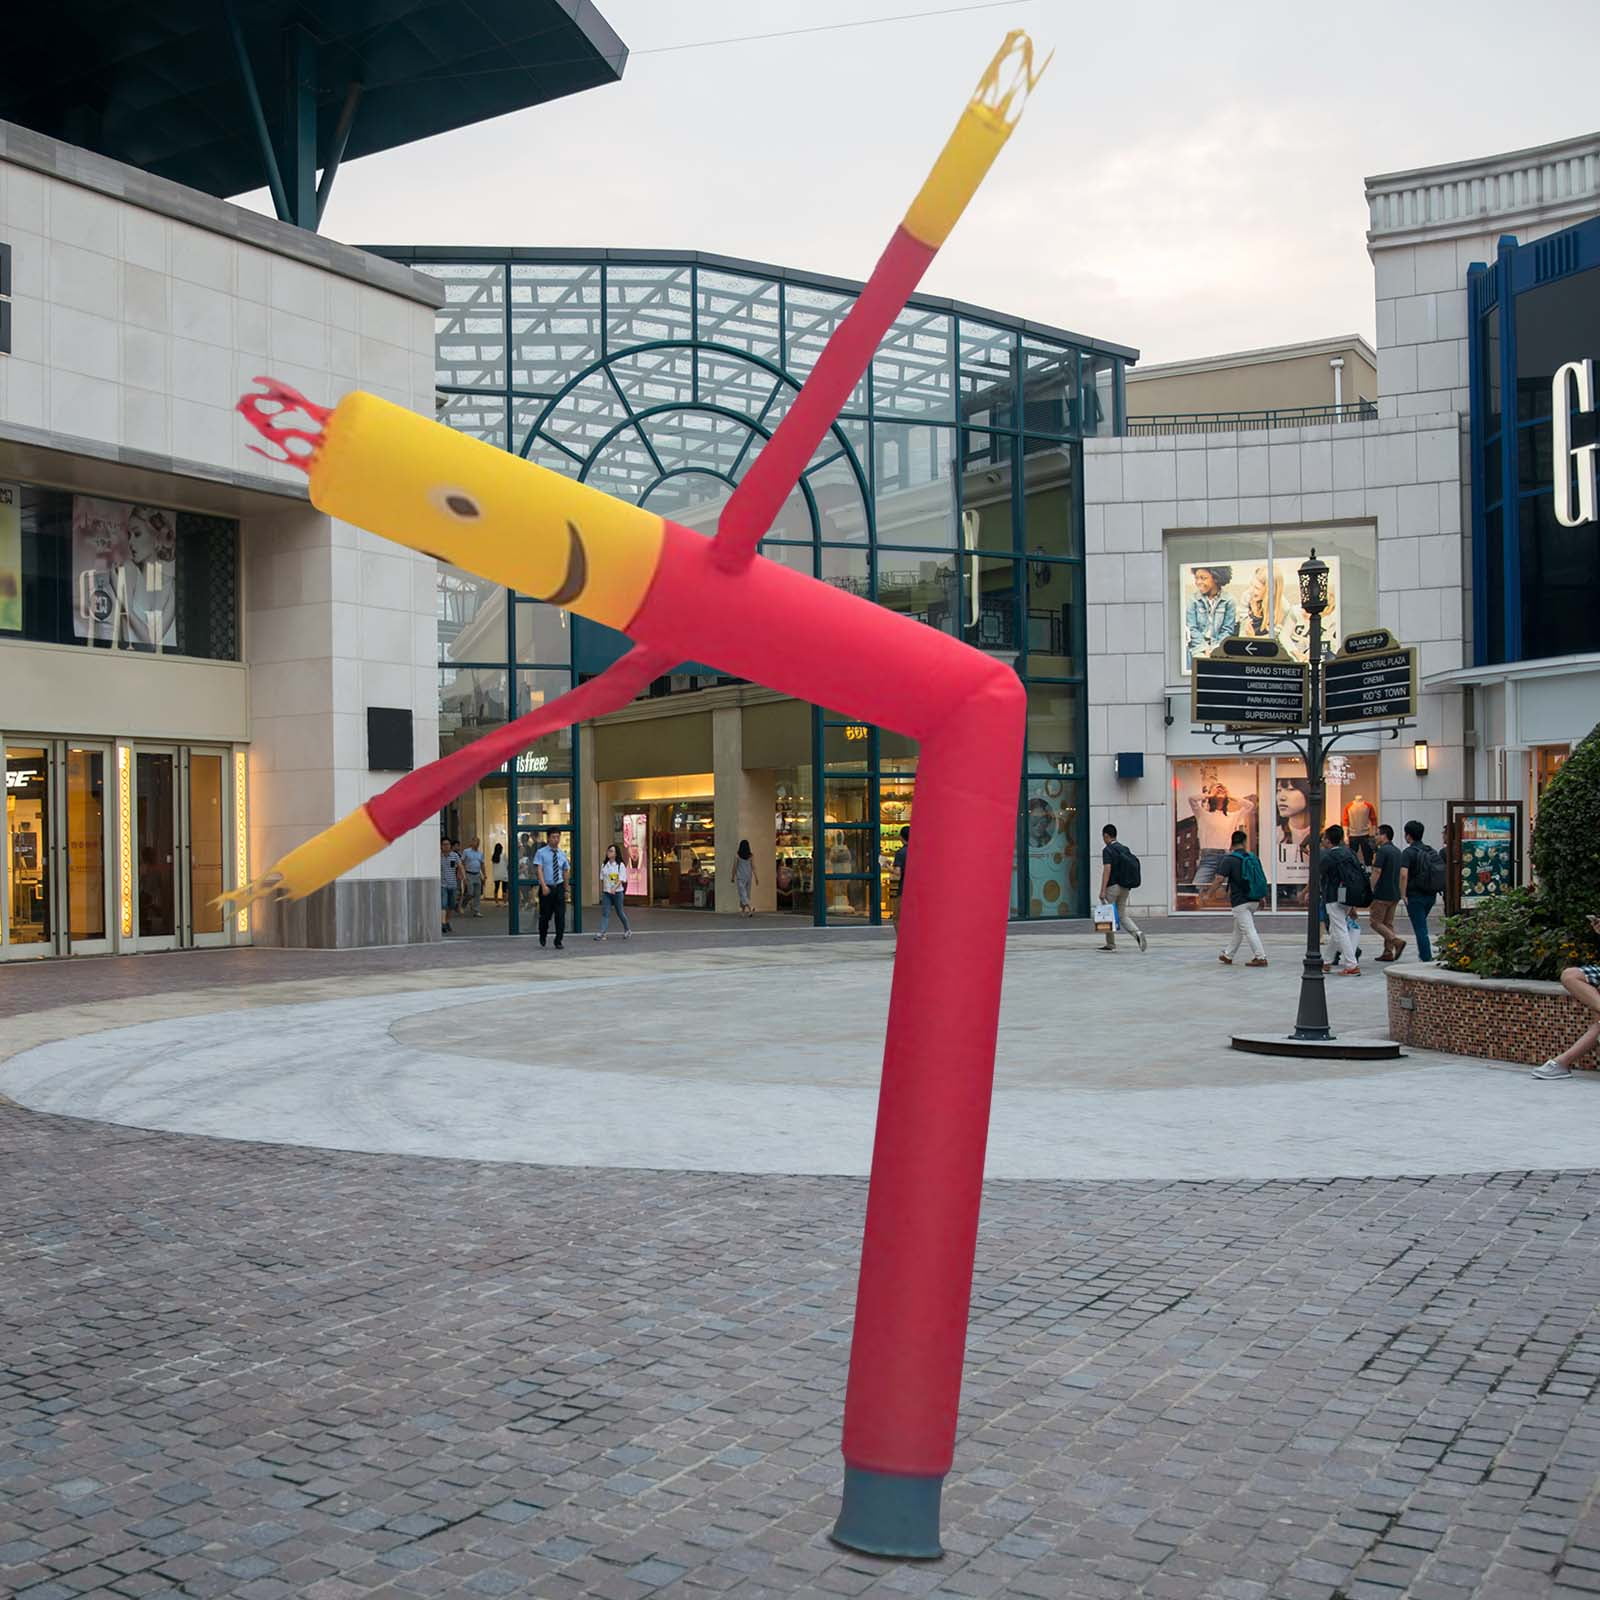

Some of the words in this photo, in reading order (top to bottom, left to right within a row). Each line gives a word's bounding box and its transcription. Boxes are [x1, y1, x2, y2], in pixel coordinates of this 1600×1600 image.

[1362, 660, 1386, 670] CENTRAL
[1387, 656, 1406, 666] PLAZA
[1245, 666, 1271, 675] BRAND
[1272, 667, 1301, 676] STREET
[1363, 675, 1385, 685] CINEMA
[1283, 683, 1300, 691] STREET
[1384, 687, 1407, 697] TOWN
[1247, 696, 1262, 704] PARK
[1263, 697, 1287, 705] PARKING
[1288, 697, 1299, 705] LOT
[1363, 706, 1373, 715] ICE
[1373, 705, 1388, 714] RINK
[1245, 711, 1298, 720] SUPERMARKET
